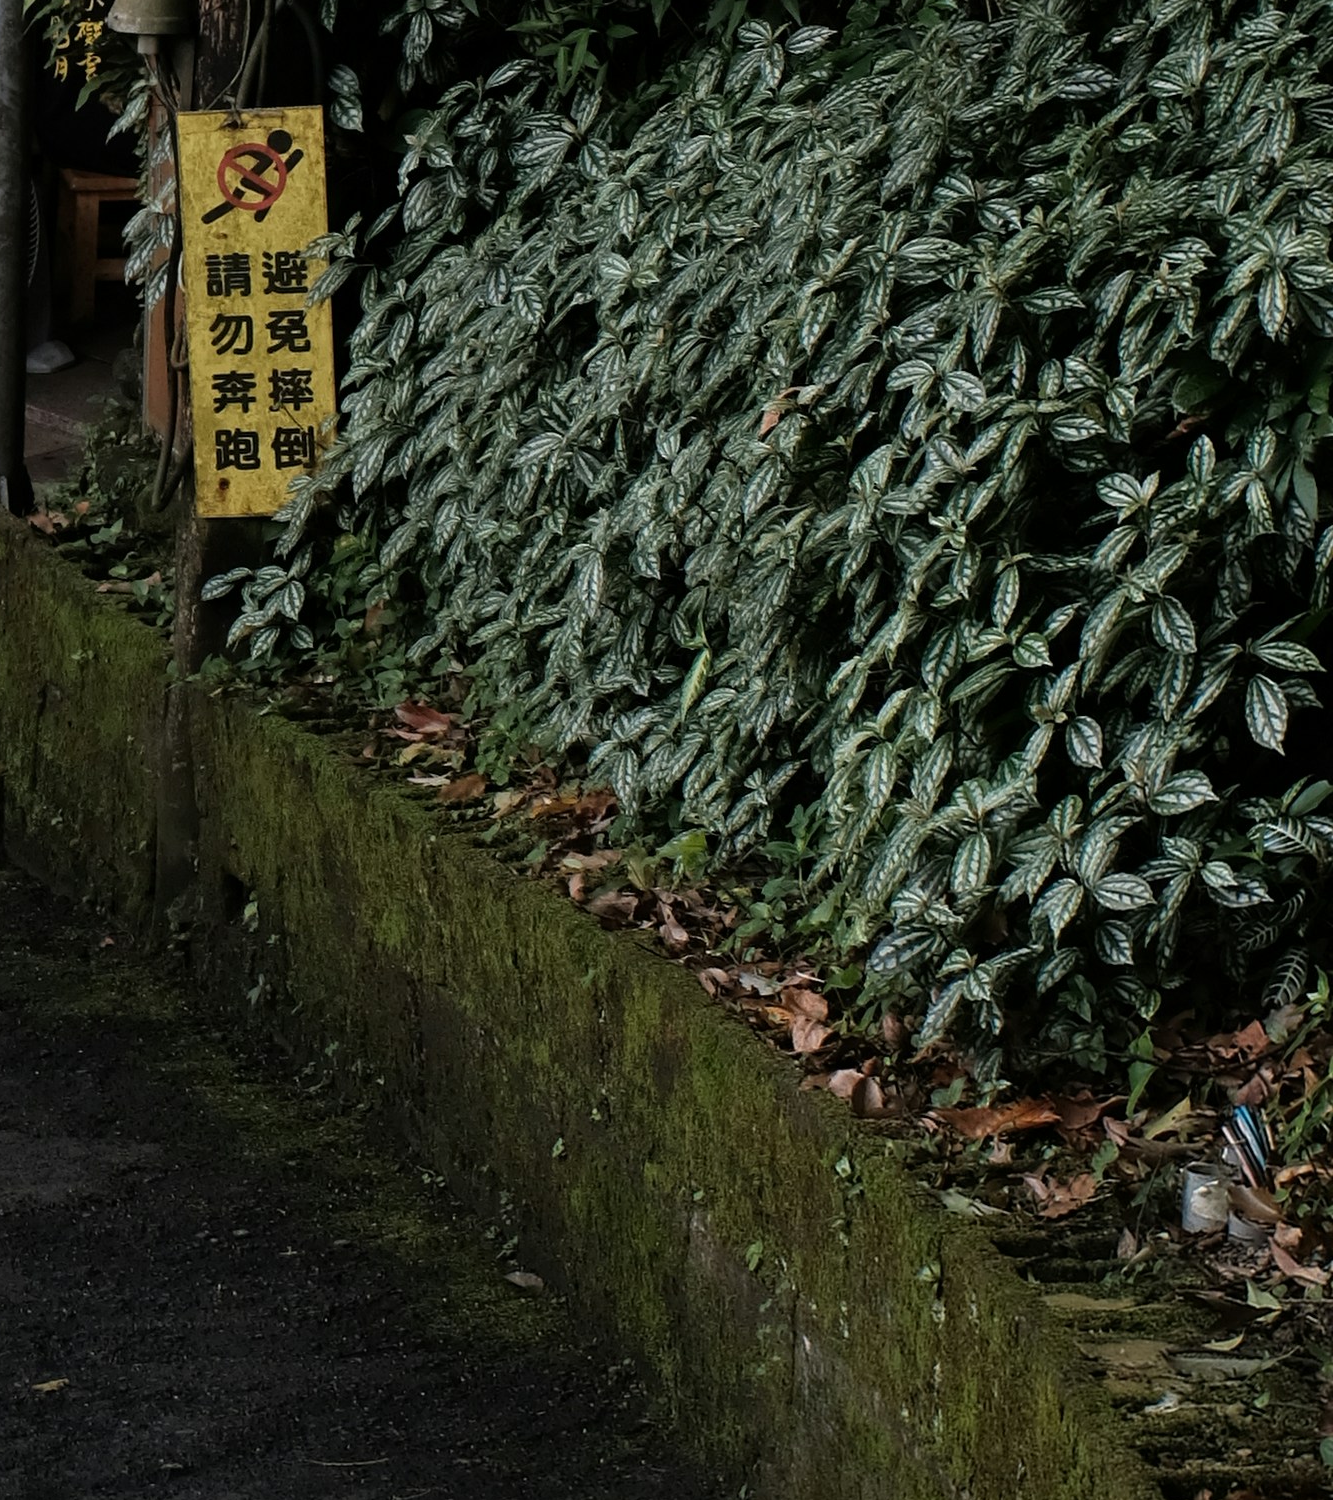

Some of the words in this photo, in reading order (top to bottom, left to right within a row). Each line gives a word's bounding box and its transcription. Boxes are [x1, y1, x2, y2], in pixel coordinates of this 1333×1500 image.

[204, 251, 262, 472] 請勿奔跑
[262, 249, 317, 470] 避免摔倒
